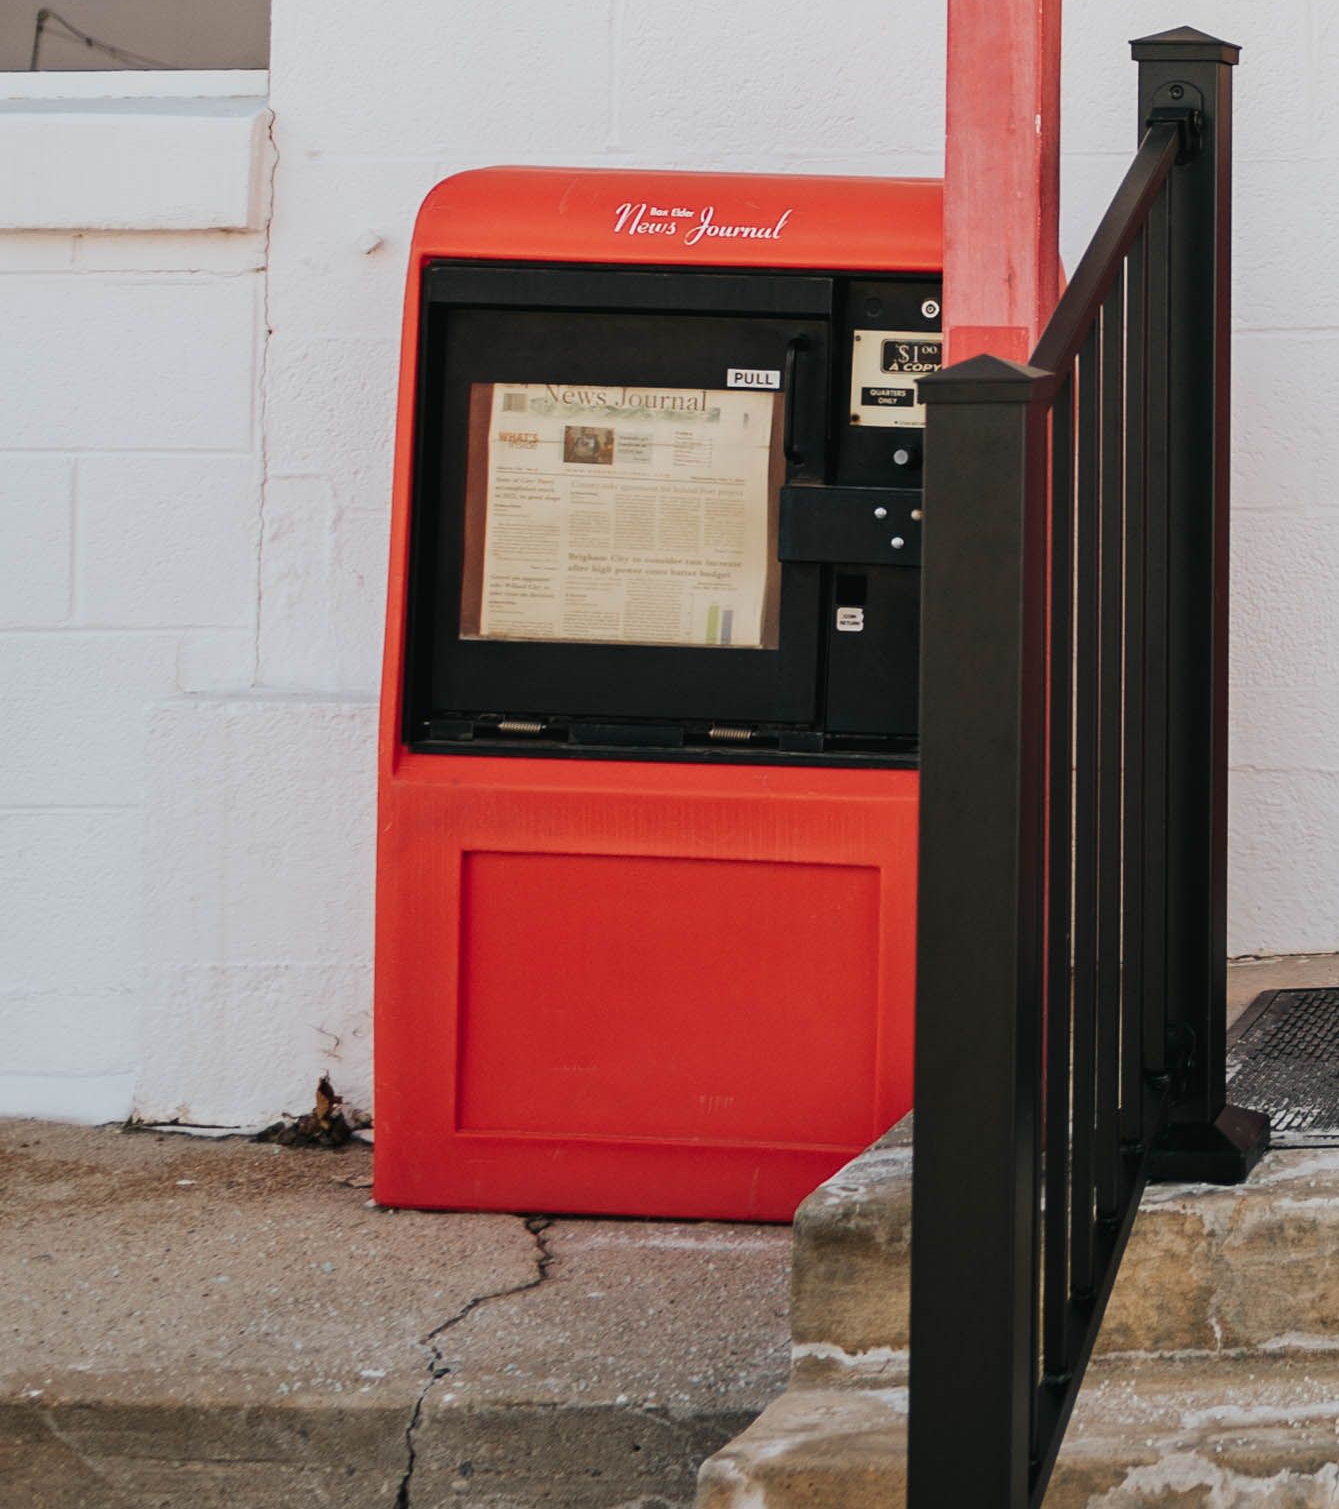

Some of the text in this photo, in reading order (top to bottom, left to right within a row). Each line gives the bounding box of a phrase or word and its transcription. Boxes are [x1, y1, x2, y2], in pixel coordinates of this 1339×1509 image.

[650, 207, 695, 218] Box Elder
[614, 203, 793, 246] News Journal
[889, 362, 942, 372] A COPY
[734, 372, 774, 385] PULL
[544, 383, 707, 413] News Journal
[870, 388, 907, 398] QUARTERS
[878, 397, 898, 405] ONLY
